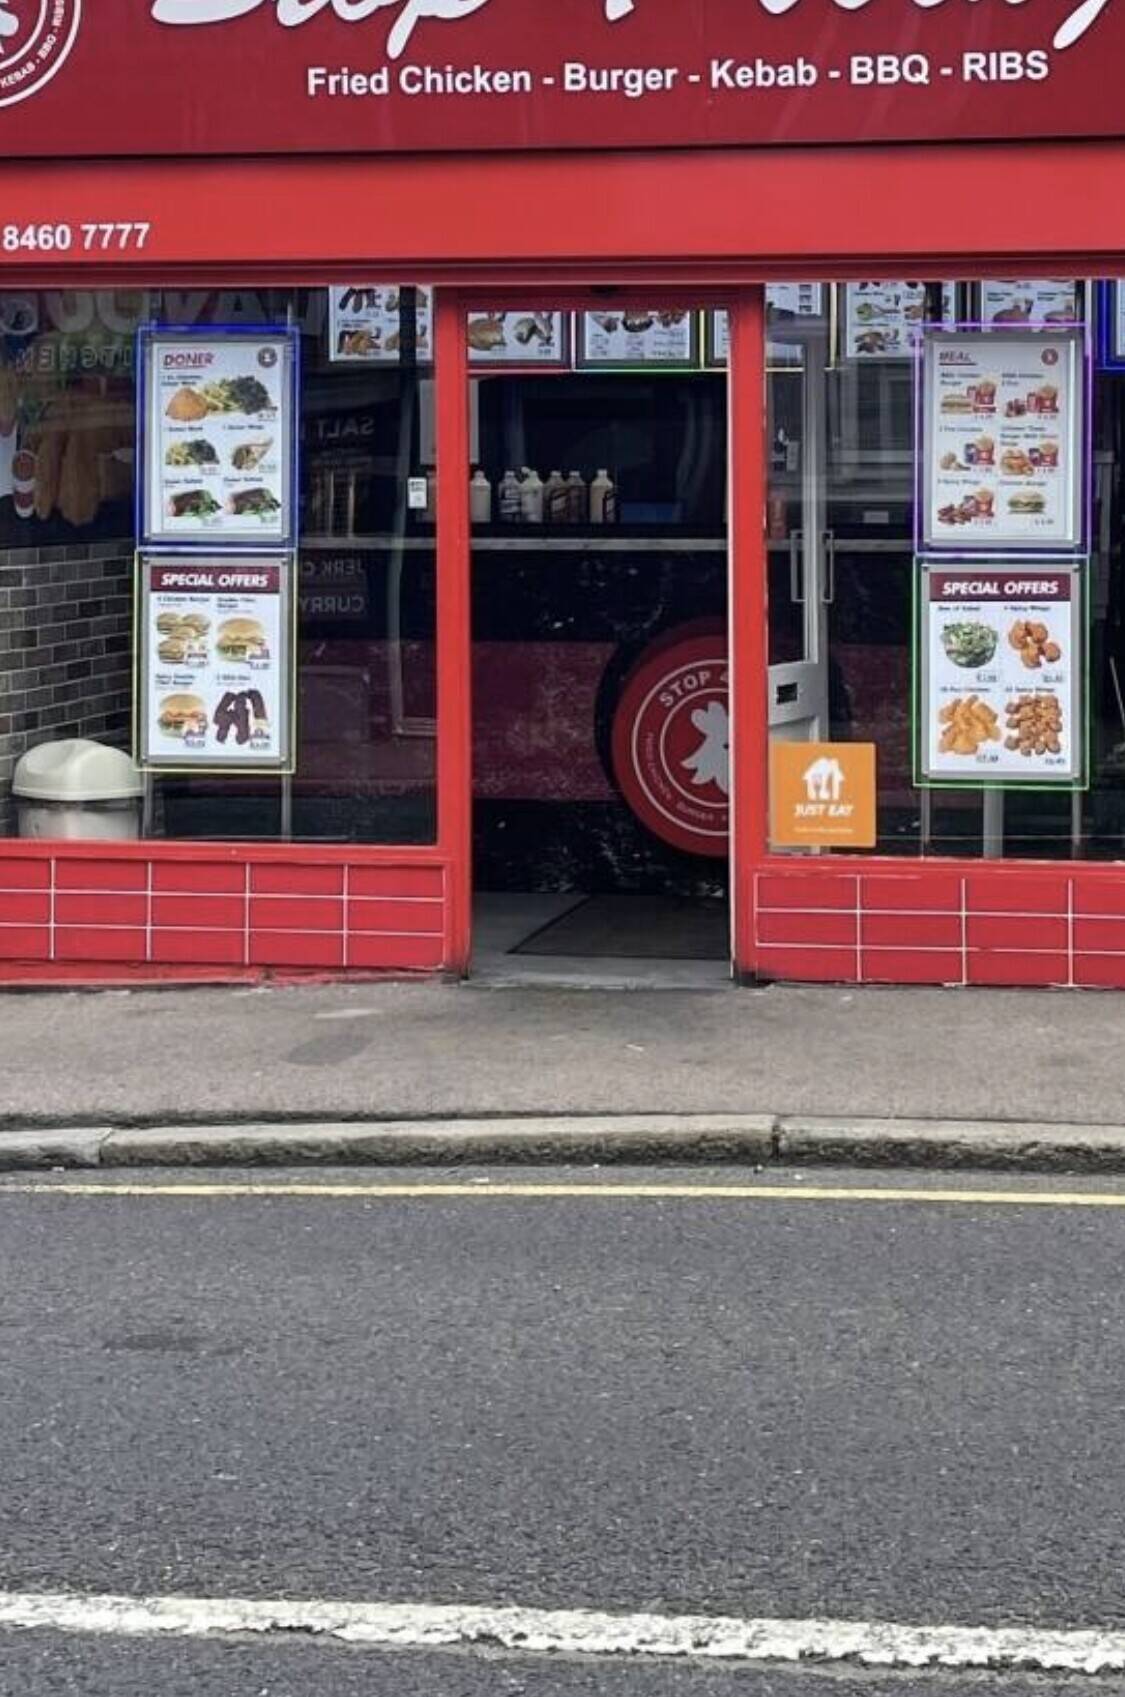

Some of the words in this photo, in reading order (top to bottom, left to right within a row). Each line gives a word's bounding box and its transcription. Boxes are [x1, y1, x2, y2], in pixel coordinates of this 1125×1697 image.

[308, 66, 389, 95] Fried
[399, 65, 531, 94] Chicken
[564, 62, 678, 98] Burger
[711, 57, 818, 88] Kebab
[850, 54, 930, 85] BBQ
[963, 50, 1049, 81] RIBS
[2, 224, 72, 251] 8460
[80, 222, 150, 250] 7777
[163, 350, 216, 367] DONER
[160, 573, 215, 587] SPECIAL
[218, 573, 270, 588] OFFERS
[942, 581, 1000, 596] SPECIAL
[1003, 580, 1060, 595] OFFERS
[658, 671, 711, 708] STOP
[794, 804, 825, 818] JUST
[828, 804, 854, 817] EAT
